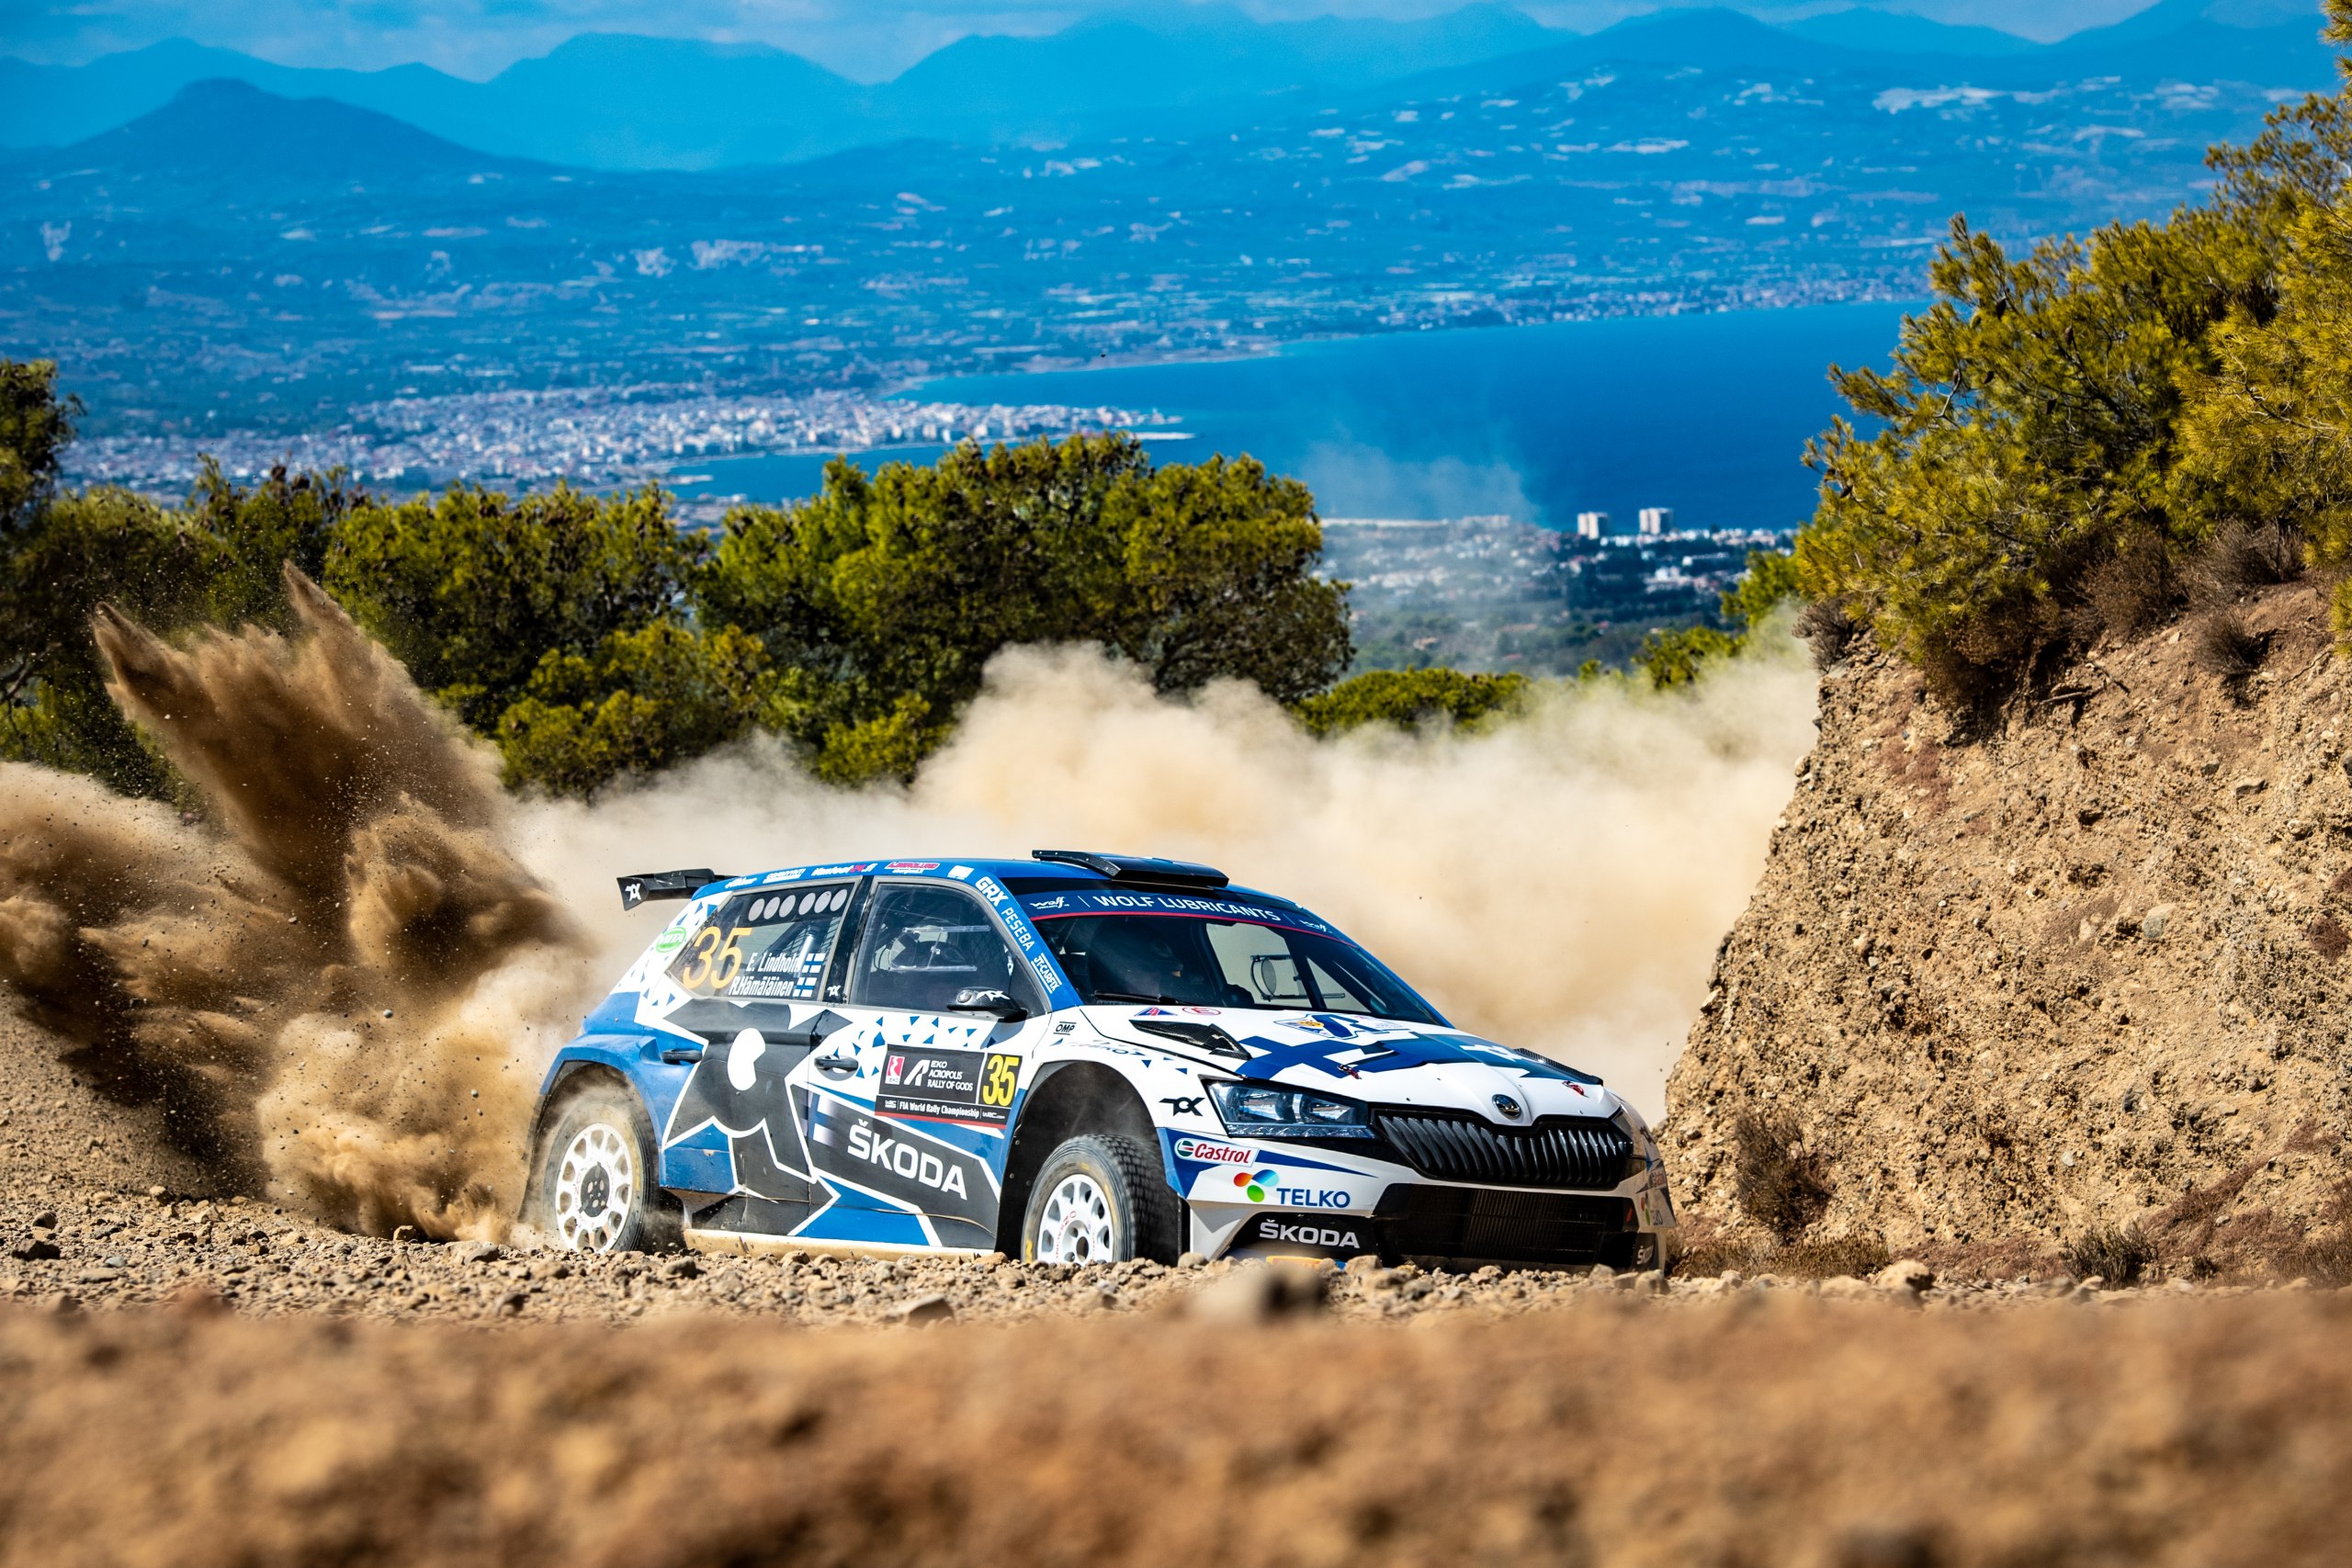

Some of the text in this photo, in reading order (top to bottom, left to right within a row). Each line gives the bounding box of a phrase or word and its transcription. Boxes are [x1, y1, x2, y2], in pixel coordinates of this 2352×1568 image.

[975, 876, 1009, 907] GRX
[1092, 896, 1282, 921] WOLF LUBRICANTS
[1001, 907, 1035, 951] PESEBA
[683, 926, 752, 989] 35
[746, 953, 758, 972] E.
[1056, 1023, 1075, 1033] OMP
[927, 1078, 973, 1091] RALLY OF GODS
[929, 1069, 963, 1080] ACROPOLIS
[982, 1055, 1019, 1106] 35
[899, 1100, 979, 1119] FIA World Rally Championship
[847, 1118, 967, 1201] ŠKODA
[1194, 1143, 1251, 1164] Castrol
[1276, 1188, 1351, 1208] TELKO
[1259, 1218, 1360, 1249] ŠKODA
